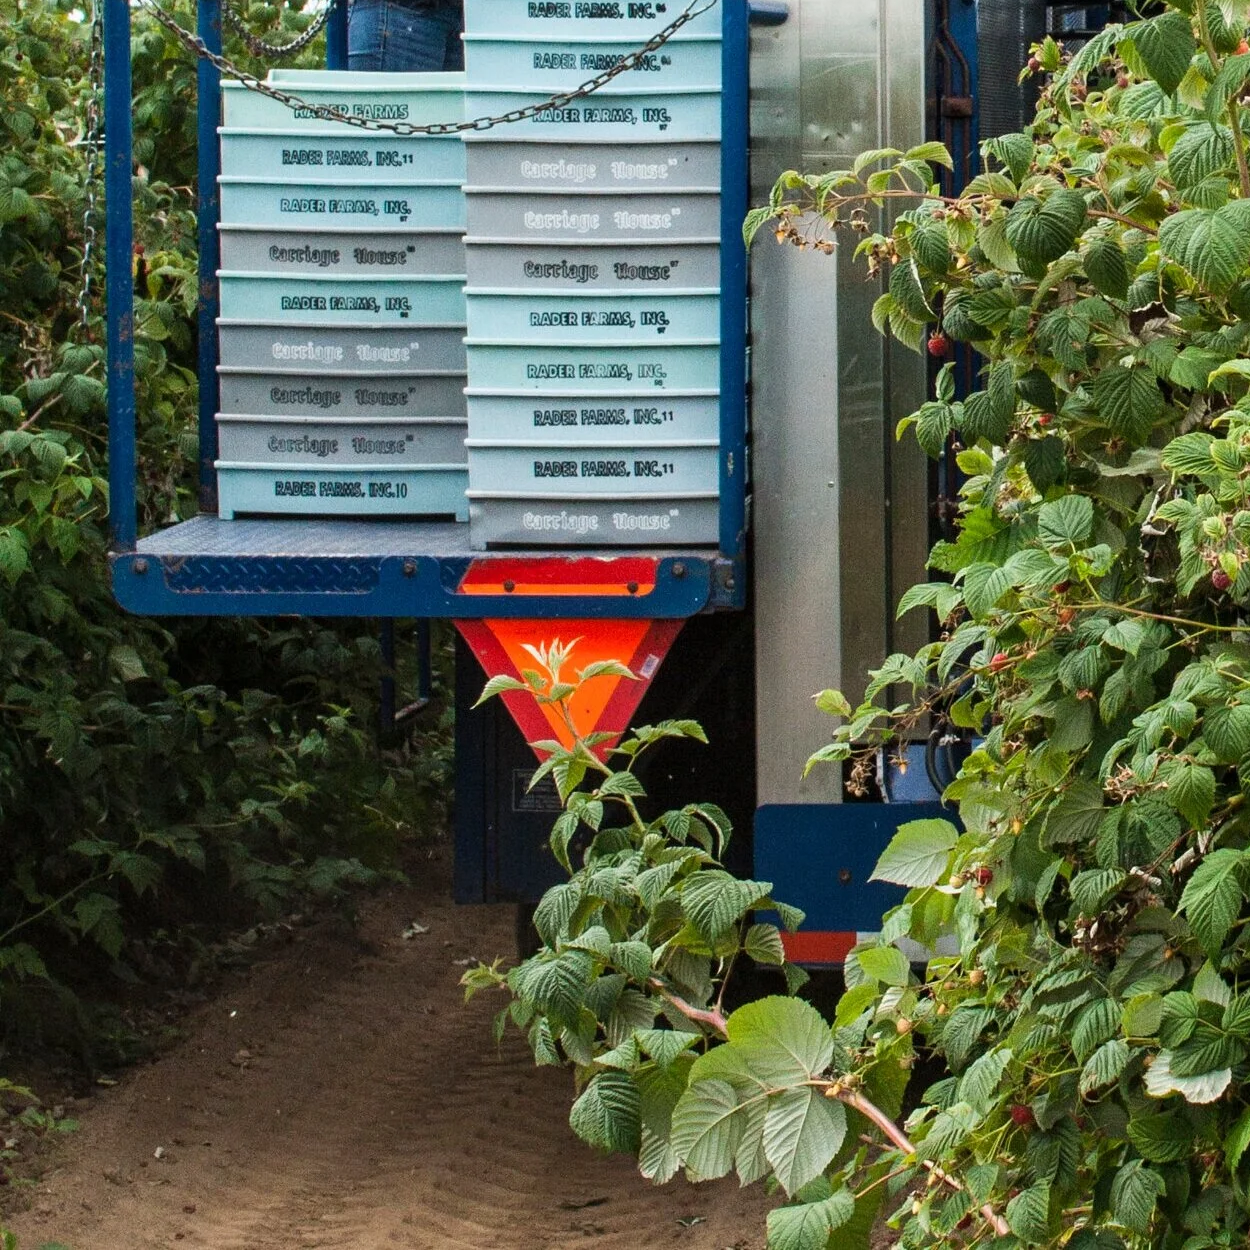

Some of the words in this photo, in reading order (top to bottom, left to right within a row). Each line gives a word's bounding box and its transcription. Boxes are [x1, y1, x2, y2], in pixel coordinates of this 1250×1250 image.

[528, 2, 571, 17] RADER
[628, 3, 655, 18] INC.
[534, 53, 576, 69] RADER
[353, 104, 409, 119] FARMS
[533, 108, 580, 122] RADER
[643, 108, 671, 121] INC.
[283, 150, 323, 164] RADER
[521, 160, 596, 182] Carriage
[281, 199, 325, 212] RADER
[385, 201, 411, 214] INC.
[525, 210, 599, 233] Carriage
[270, 245, 340, 265] Carriage
[524, 260, 598, 283] Carriage
[282, 297, 326, 309] RADER
[386, 297, 411, 310] INC.
[531, 312, 577, 326] RADER
[641, 312, 669, 325] INC.
[273, 342, 343, 362] Carriage
[528, 365, 575, 378] RADER
[638, 364, 667, 377] INC.
[271, 387, 341, 406] Carriage
[534, 410, 577, 426] RADER
[268, 434, 338, 455] Carriage
[535, 462, 577, 477] RADER
[276, 482, 317, 497] RADER
[523, 512, 598, 534] Carriage
